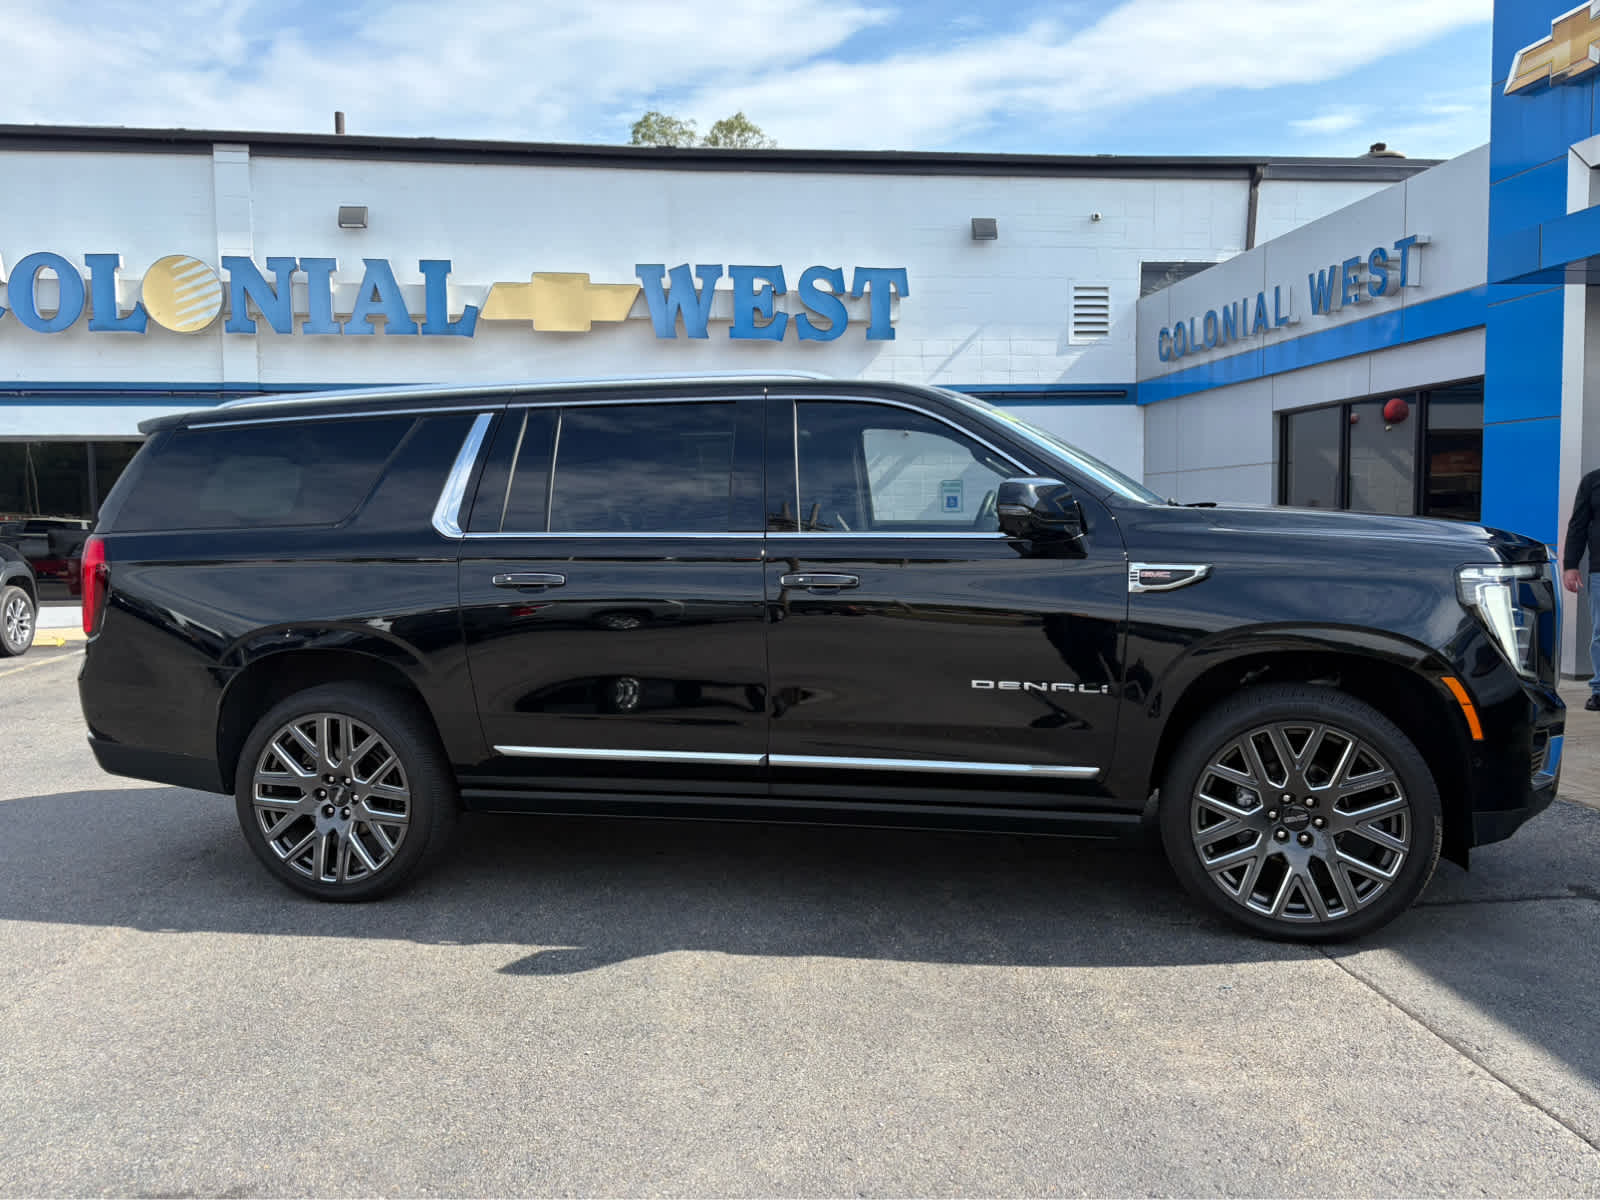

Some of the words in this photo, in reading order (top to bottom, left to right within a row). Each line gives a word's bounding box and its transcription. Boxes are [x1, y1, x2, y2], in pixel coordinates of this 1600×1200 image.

[0, 251, 478, 338] OLONIAL
[635, 264, 909, 342] WEST
[1159, 286, 1292, 362] COLONIAL
[1308, 235, 1420, 316] WEST
[971, 679, 1109, 694] DENALI
